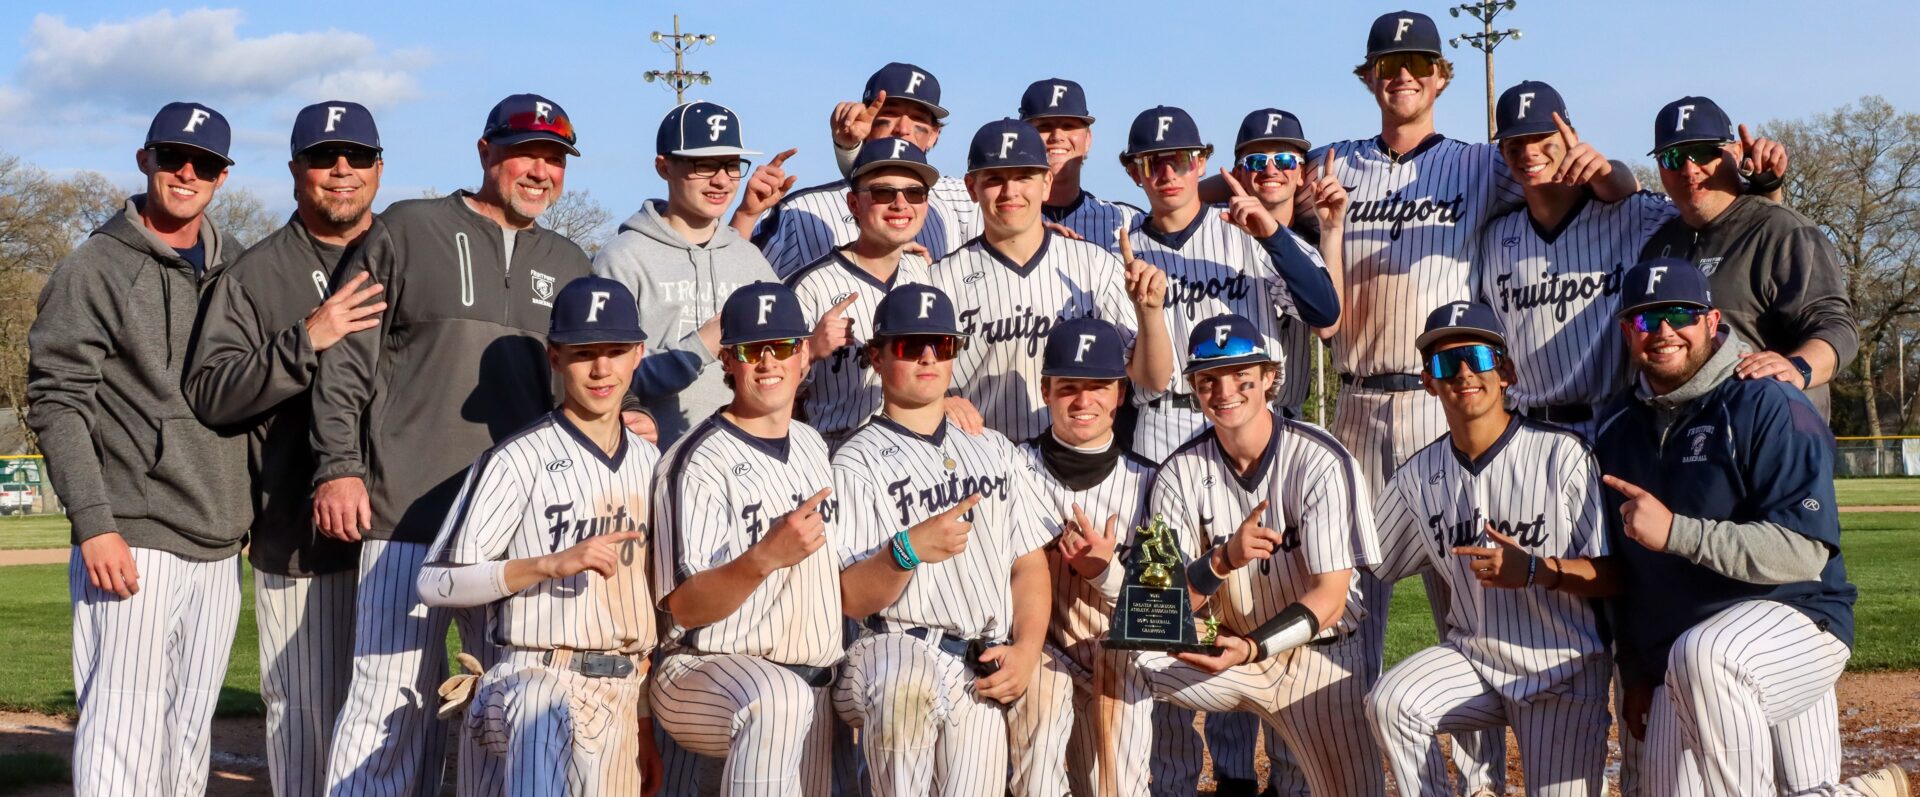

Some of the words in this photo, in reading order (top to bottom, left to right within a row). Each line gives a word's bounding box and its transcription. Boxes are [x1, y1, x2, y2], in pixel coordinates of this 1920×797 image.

[1393, 18, 1414, 41] F
[904, 70, 926, 94] F
[1049, 84, 1068, 107] F
[534, 101, 553, 125] F
[1517, 92, 1537, 119] F
[1675, 104, 1696, 132] F
[182, 108, 211, 133] F
[324, 106, 347, 133] F
[706, 114, 728, 142] F
[1155, 115, 1173, 142] F
[1264, 113, 1283, 135] F
[889, 138, 910, 159] F
[998, 132, 1019, 159] F
[1343, 185, 1466, 241] ruitport
[659, 280, 743, 302] TROJA
[1497, 262, 1624, 322] Fruitport
[1645, 266, 1669, 294] F
[586, 291, 611, 323] F
[917, 291, 938, 319] F
[1163, 269, 1251, 322] itport
[757, 294, 777, 325] F
[1447, 303, 1470, 327] F
[959, 306, 1052, 358] Fruitp
[1214, 324, 1233, 347] F
[1074, 334, 1097, 363] F
[544, 500, 649, 567] Fruitpo
